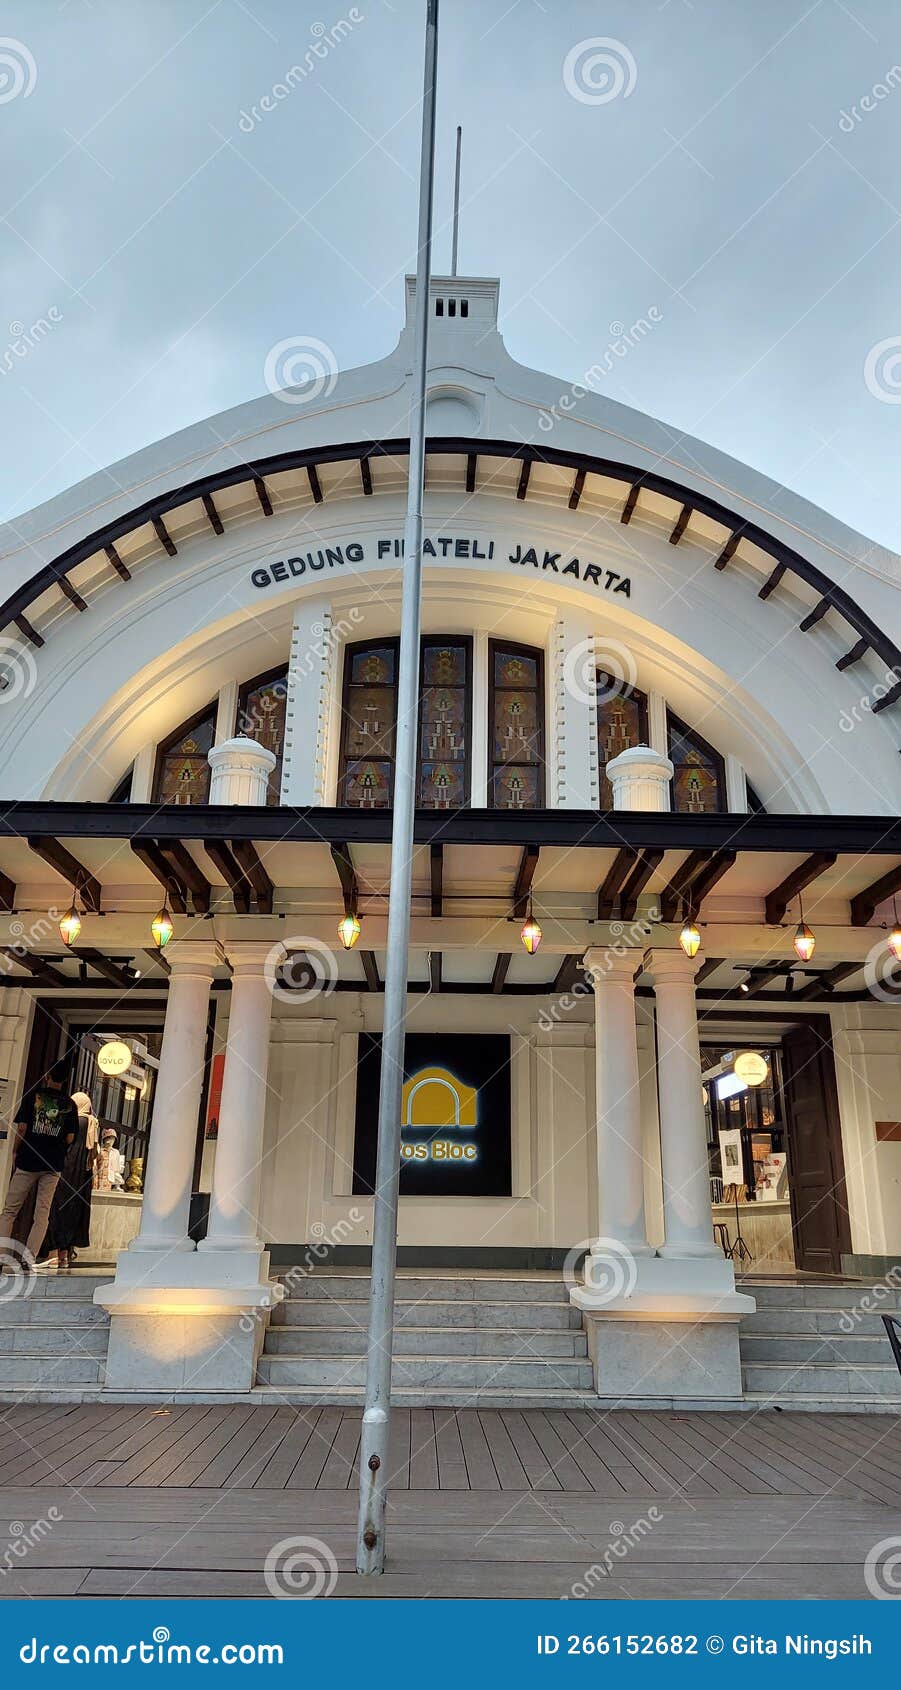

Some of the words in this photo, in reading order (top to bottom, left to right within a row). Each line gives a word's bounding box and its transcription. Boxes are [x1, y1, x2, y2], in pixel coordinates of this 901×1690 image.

[250, 543, 365, 588] GEDUNG
[508, 544, 632, 599] JAKARTA
[400, 1141, 428, 1160] os
[431, 1139, 478, 1161] Bloc
